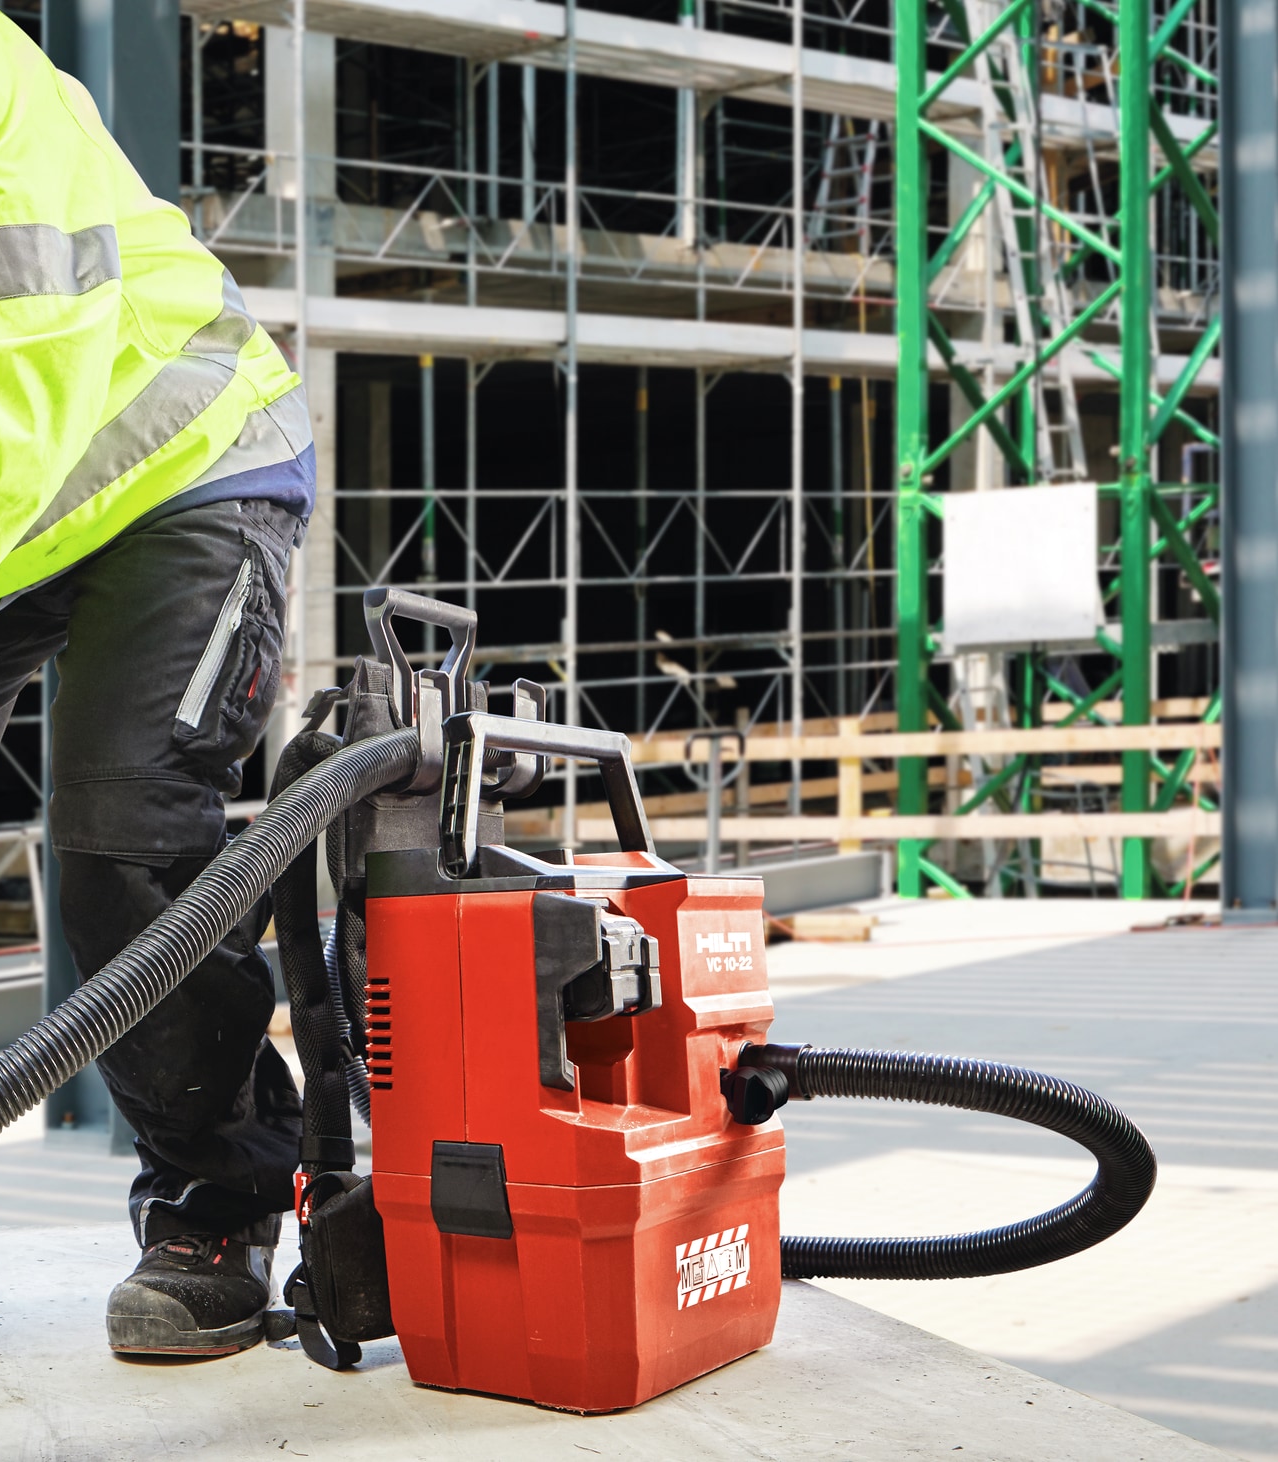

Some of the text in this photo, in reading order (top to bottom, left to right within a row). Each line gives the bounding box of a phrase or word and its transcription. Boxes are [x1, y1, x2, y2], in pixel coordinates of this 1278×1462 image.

[695, 932, 752, 953] HILTI
[705, 955, 753, 973] VC 10-22
[681, 1243, 745, 1290] M M
